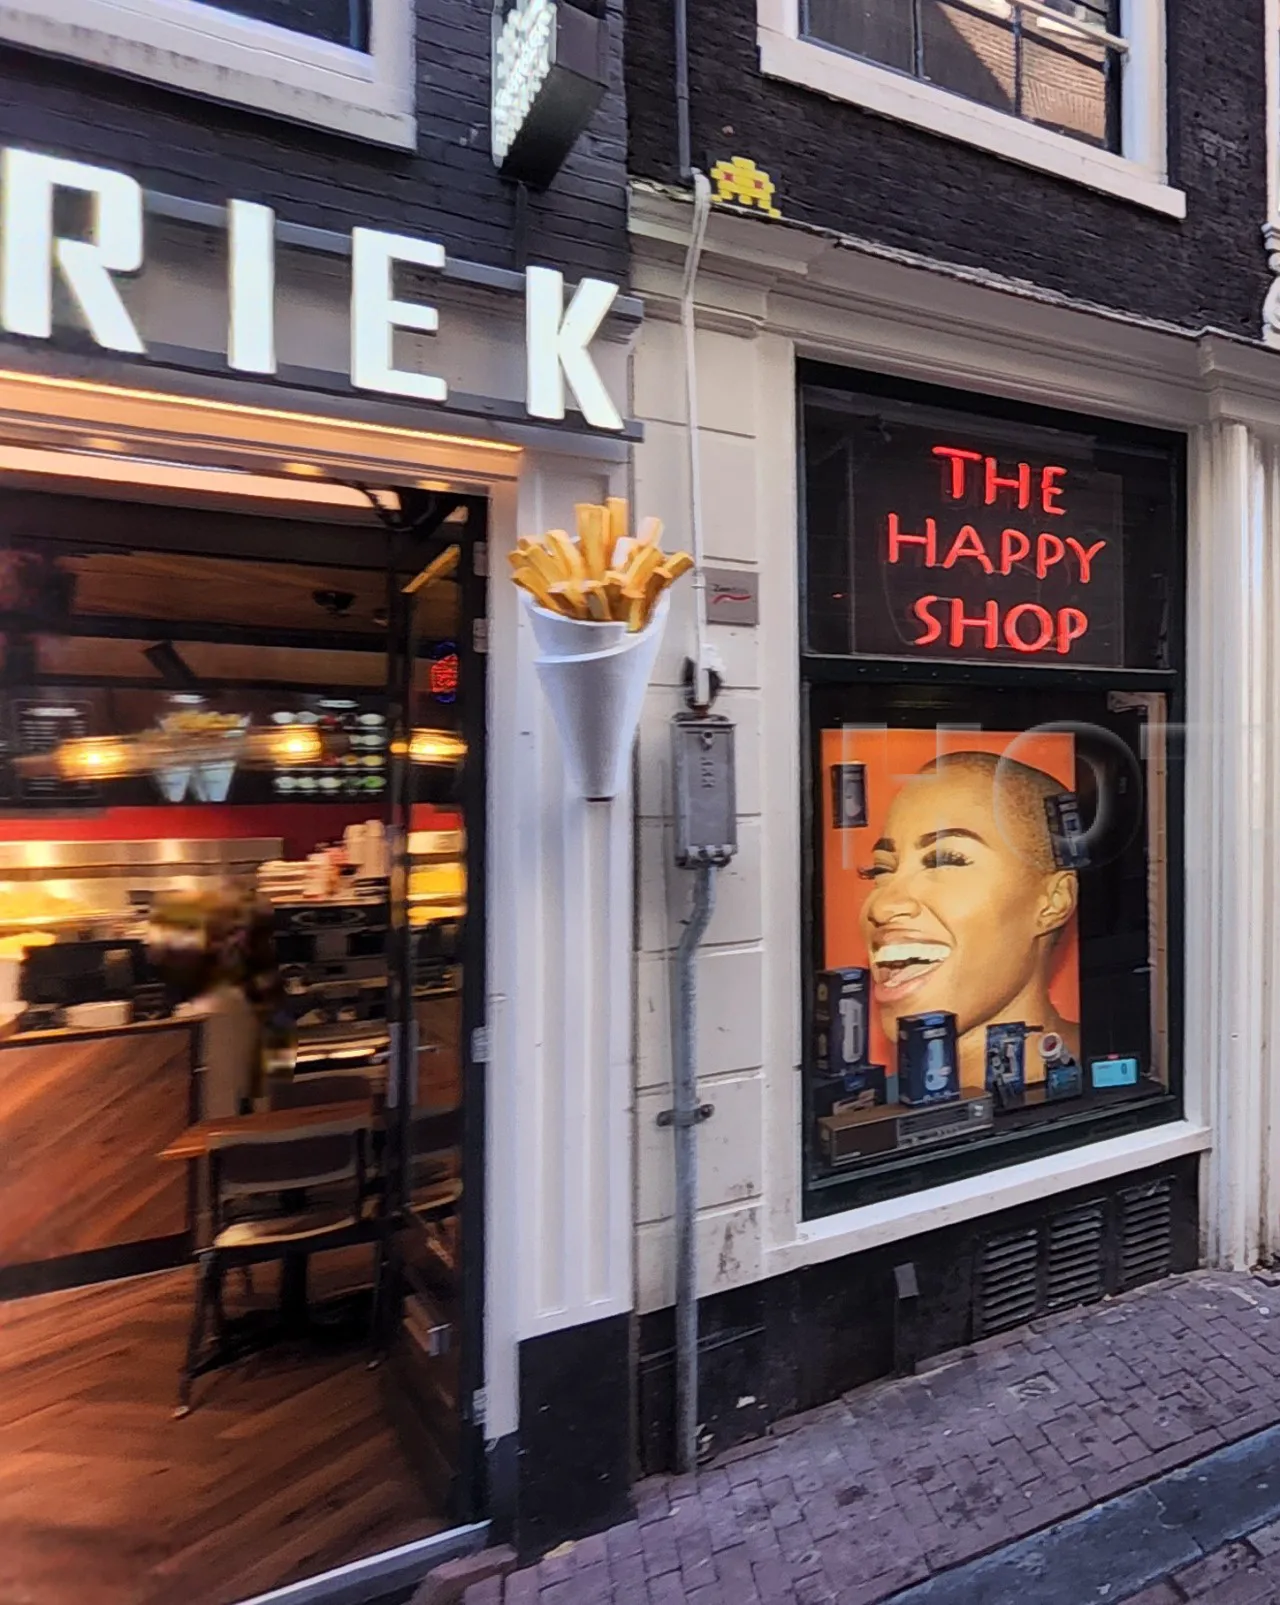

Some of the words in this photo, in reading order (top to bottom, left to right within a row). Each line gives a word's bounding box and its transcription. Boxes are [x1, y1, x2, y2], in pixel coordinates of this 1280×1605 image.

[931, 446, 1069, 516] THE
[886, 512, 1107, 584] HAPPY
[912, 595, 1089, 654] SHOP
